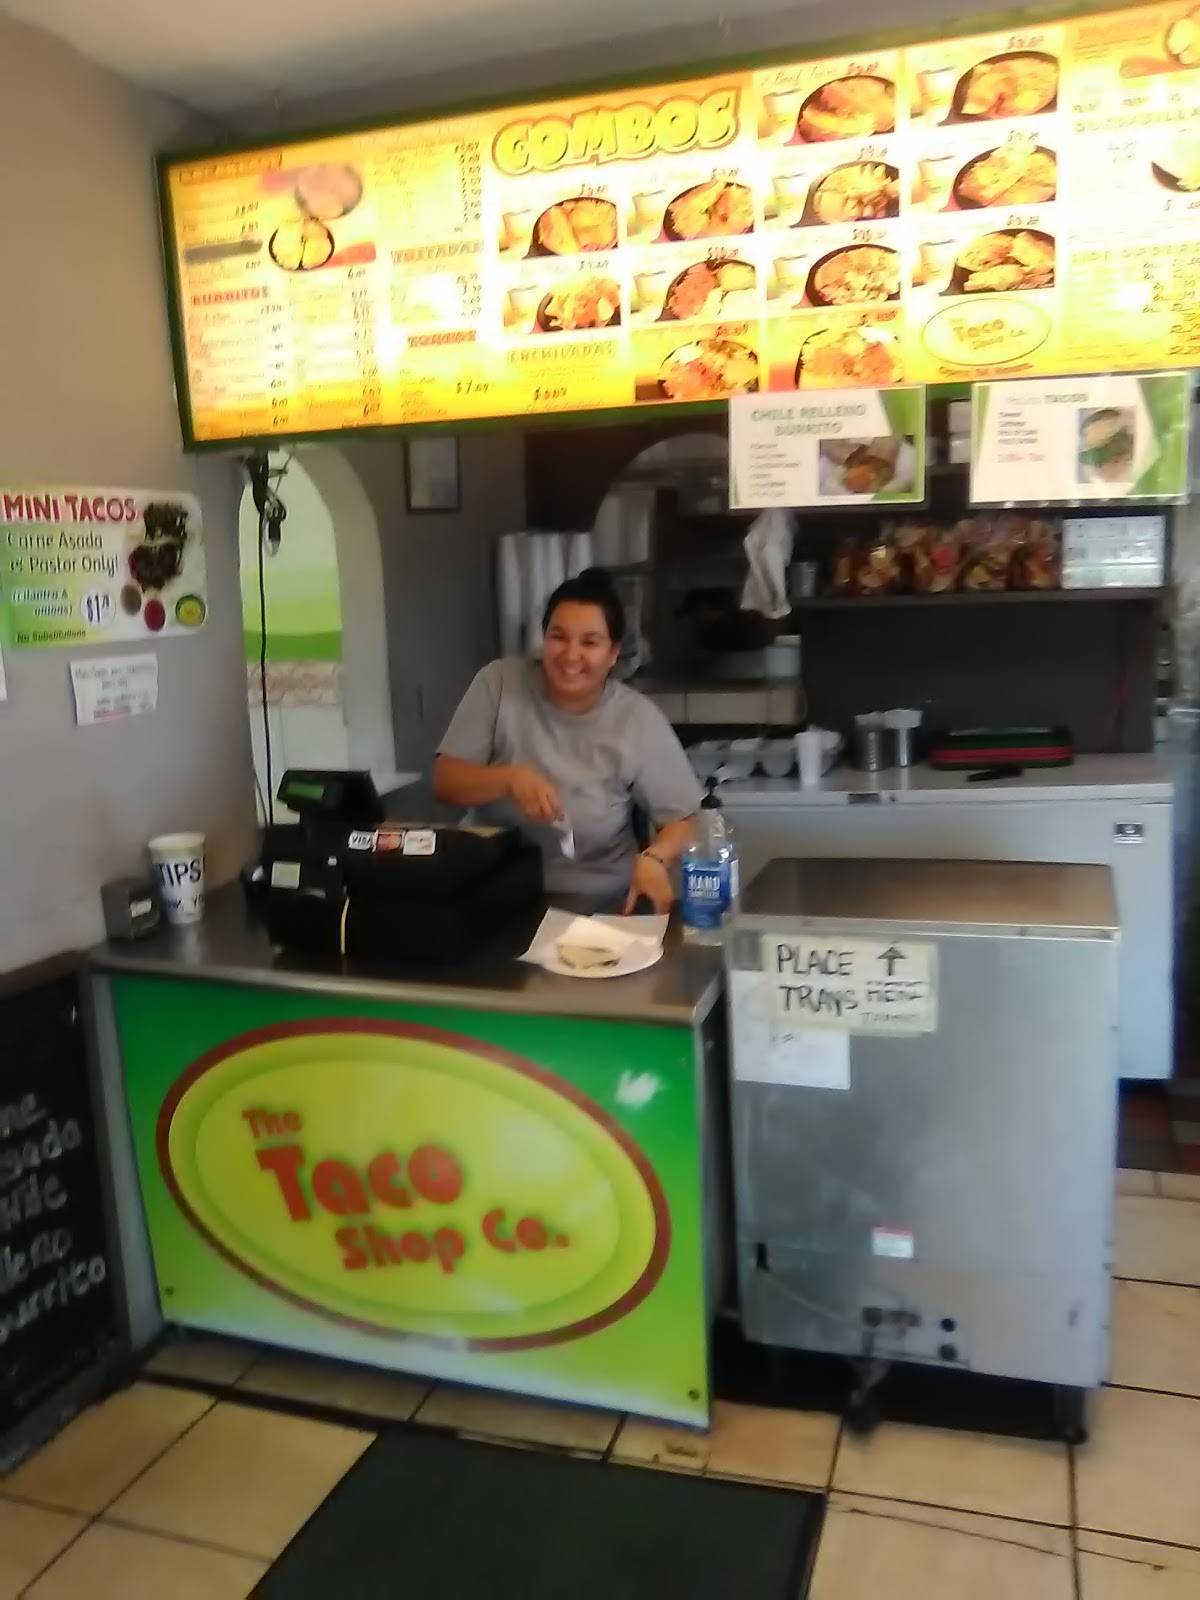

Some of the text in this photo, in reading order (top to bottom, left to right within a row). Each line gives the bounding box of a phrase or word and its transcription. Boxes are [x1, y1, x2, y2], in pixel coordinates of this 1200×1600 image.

[492, 87, 741, 176] COMBOS
[3, 494, 138, 522] MINI TACOS
[58, 529, 104, 548] Asada
[776, 944, 856, 976] PLACE
[779, 984, 859, 1016] TRAYS
[242, 1108, 303, 1140] The
[255, 1144, 464, 1222] Taco
[335, 1207, 571, 1273] Shop Co.
